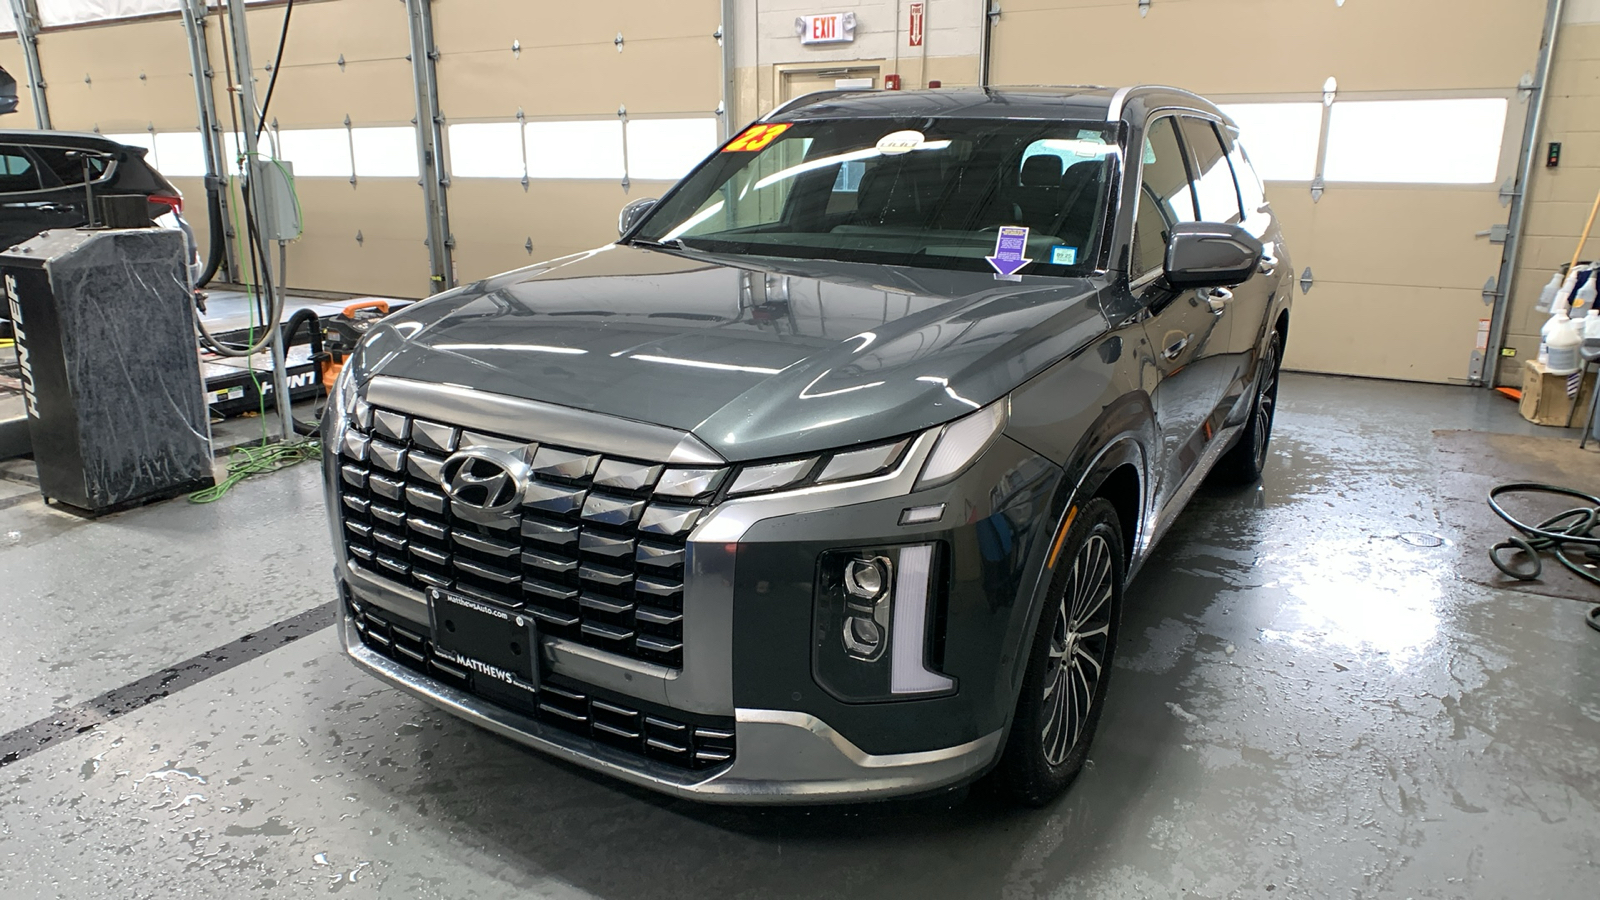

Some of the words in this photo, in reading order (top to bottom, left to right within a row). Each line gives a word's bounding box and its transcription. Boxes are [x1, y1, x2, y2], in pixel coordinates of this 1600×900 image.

[813, 16, 837, 39] EXIT
[726, 124, 787, 151] 23
[4, 273, 41, 420] HUNTER
[456, 654, 513, 684] MATTHEWS
